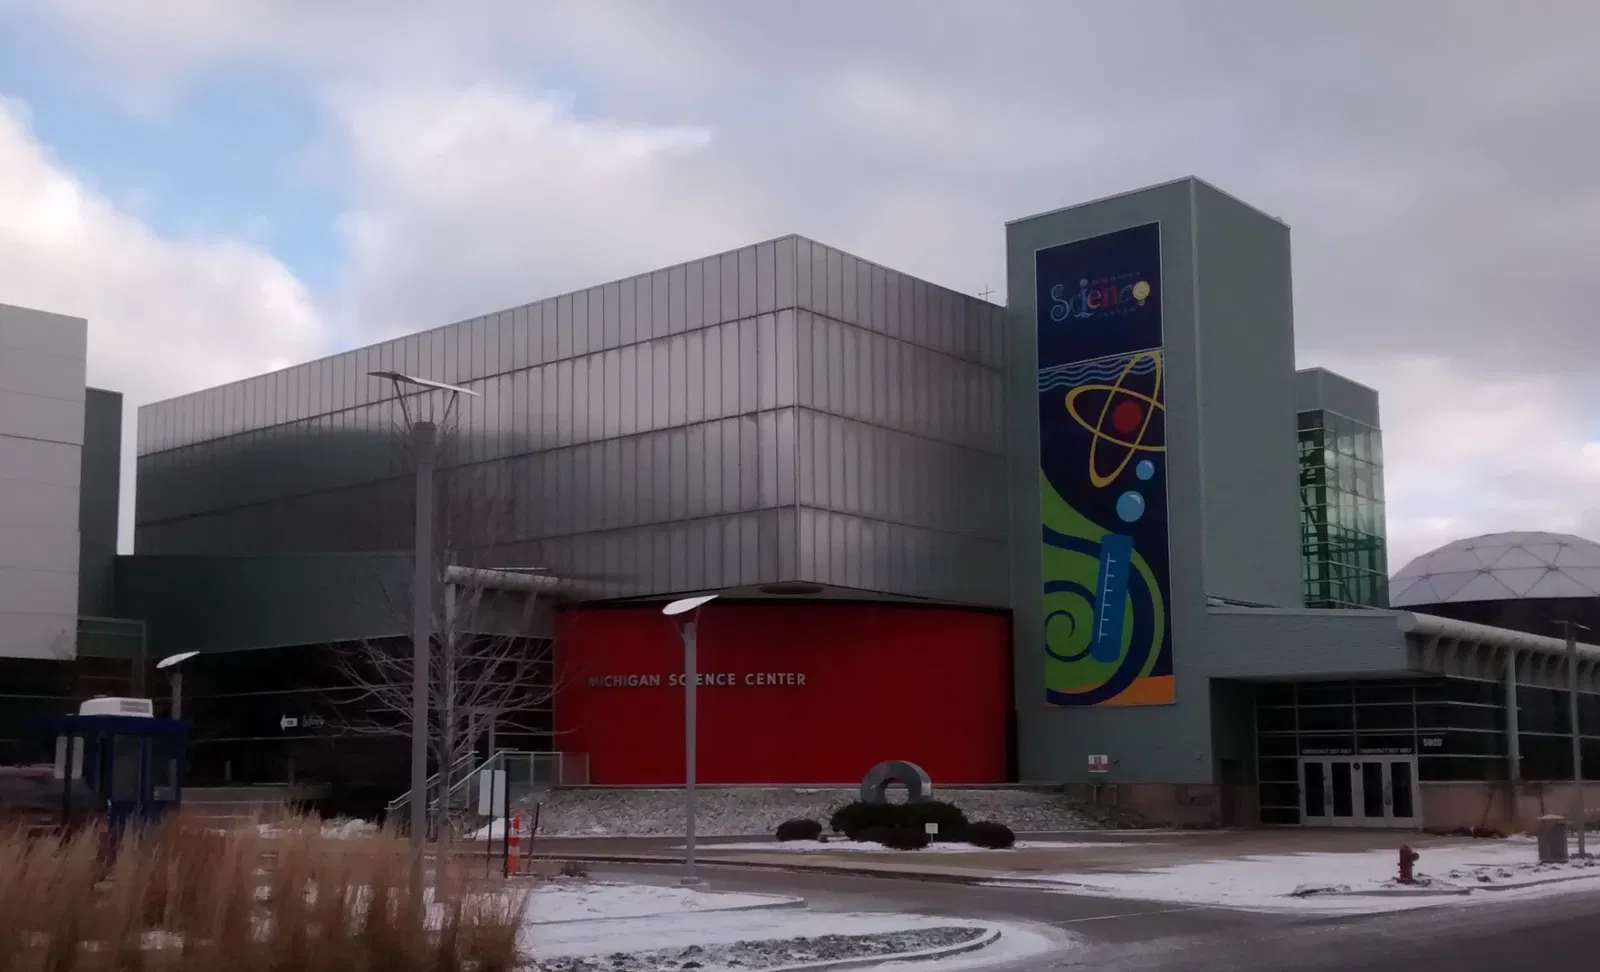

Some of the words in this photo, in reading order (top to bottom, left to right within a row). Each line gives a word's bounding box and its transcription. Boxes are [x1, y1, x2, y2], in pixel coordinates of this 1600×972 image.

[1050, 278, 1151, 322] Scienc
[587, 674, 661, 688] MICHIGAN
[669, 673, 736, 686] SCENCE
[744, 672, 807, 686] CENTER
